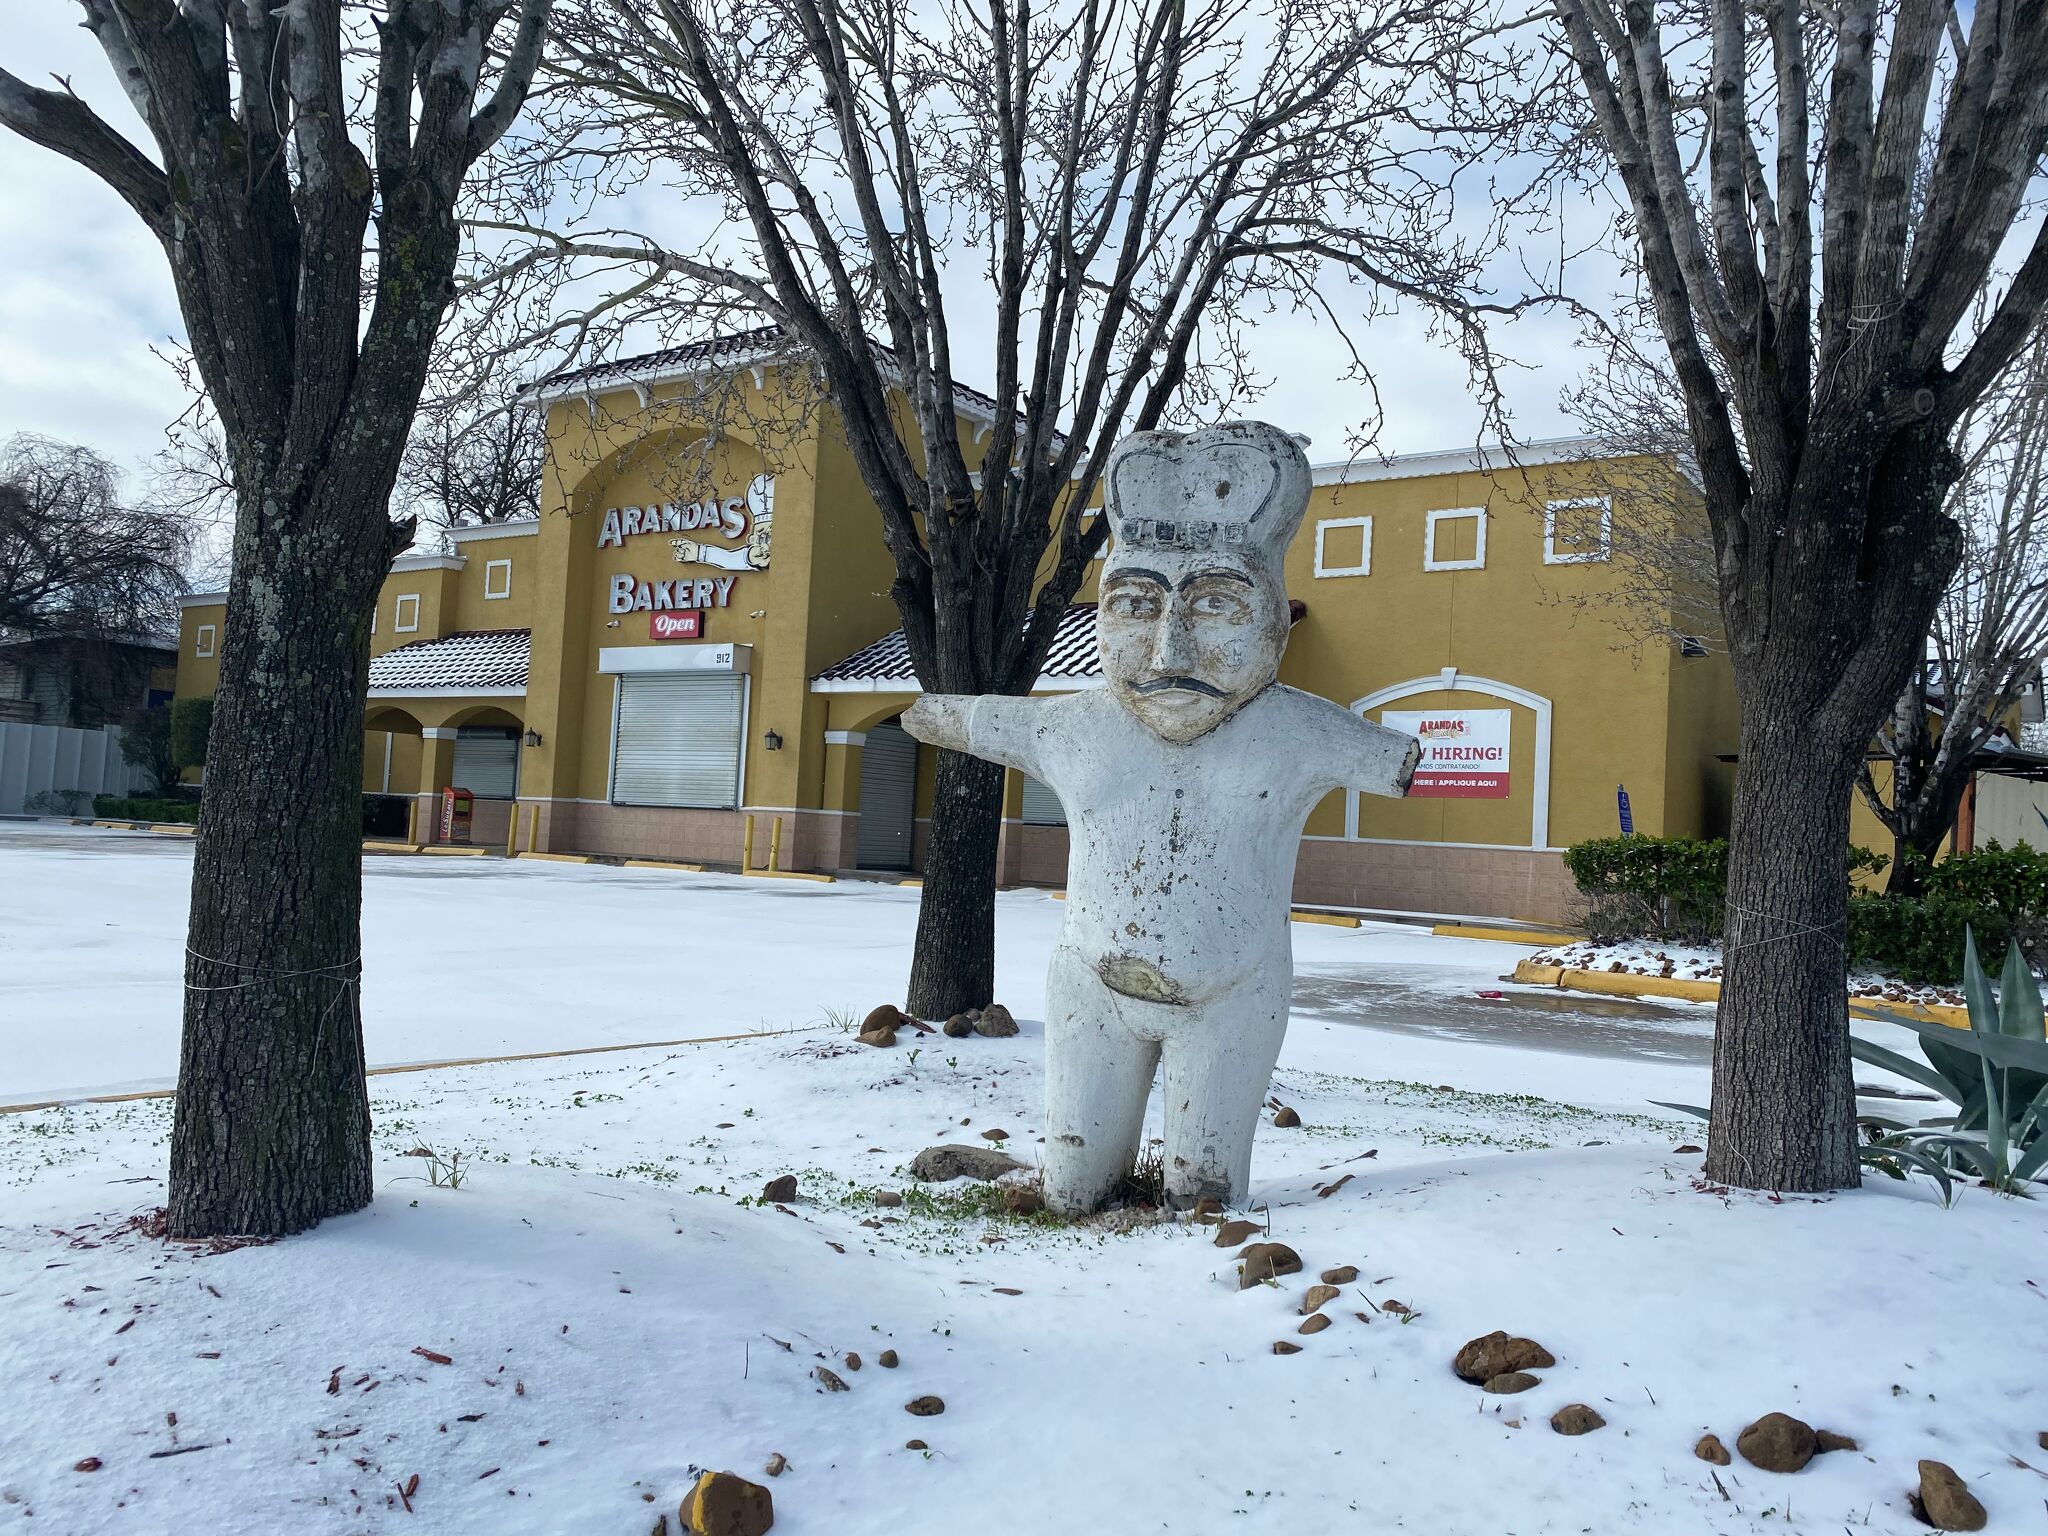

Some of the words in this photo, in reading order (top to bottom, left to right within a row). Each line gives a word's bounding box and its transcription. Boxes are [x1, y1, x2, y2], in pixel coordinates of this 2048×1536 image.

[597, 496, 748, 549] ARANDAS
[608, 573, 736, 614] BAKERY
[655, 614, 695, 637] Open
[716, 653, 730, 664] 912
[1419, 720, 1464, 734] ARANDAS
[1432, 747, 1503, 760] HIRING!
[1438, 779, 1477, 787] APPLIQUE
